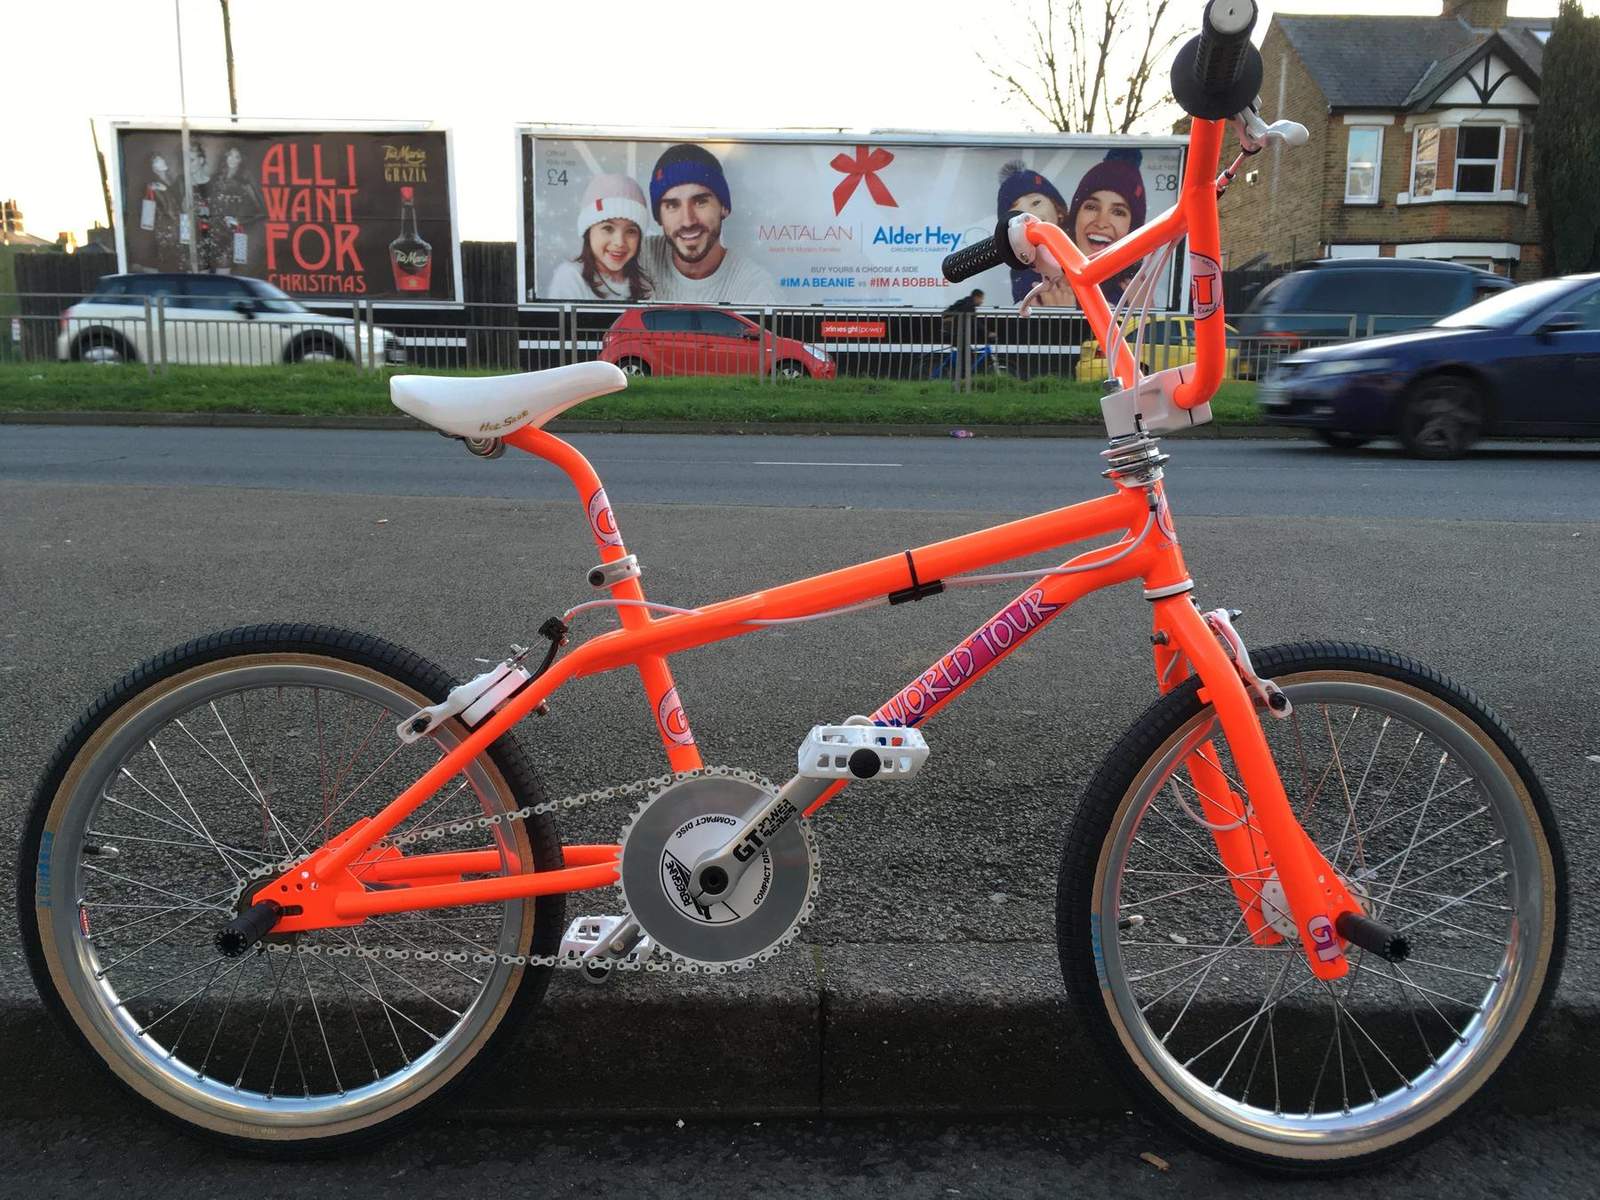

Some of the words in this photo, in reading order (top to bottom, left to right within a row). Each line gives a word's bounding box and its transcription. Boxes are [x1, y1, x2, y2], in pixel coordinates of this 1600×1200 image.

[262, 143, 336, 185] ALL
[347, 144, 356, 186] I
[384, 168, 427, 182] GRAZIA
[547, 168, 568, 186] £4
[1155, 174, 1176, 191] £8
[262, 187, 359, 222] WANT
[266, 223, 364, 271] FOR
[759, 225, 853, 240] MATALAN
[873, 226, 922, 244] Alder
[925, 226, 962, 252] Hey
[780, 277, 800, 287] #IM
[802, 278, 810, 287] A
[812, 278, 855, 287] BEANIE
[870, 278, 889, 287] #IM
[892, 278, 900, 287] A
[902, 277, 949, 287] BOBBLE
[876, 647, 975, 728] WORLD
[973, 589, 1057, 656] TOUR
[675, 821, 694, 838] DISC
[694, 815, 737, 827] COMPACT
[758, 799, 791, 833] POWER
[763, 805, 798, 837] SERIES
[733, 829, 763, 862] GT
[760, 848, 770, 863] DIS
[665, 860, 693, 906] PEREGRINE
[753, 865, 771, 905] COMPACT
